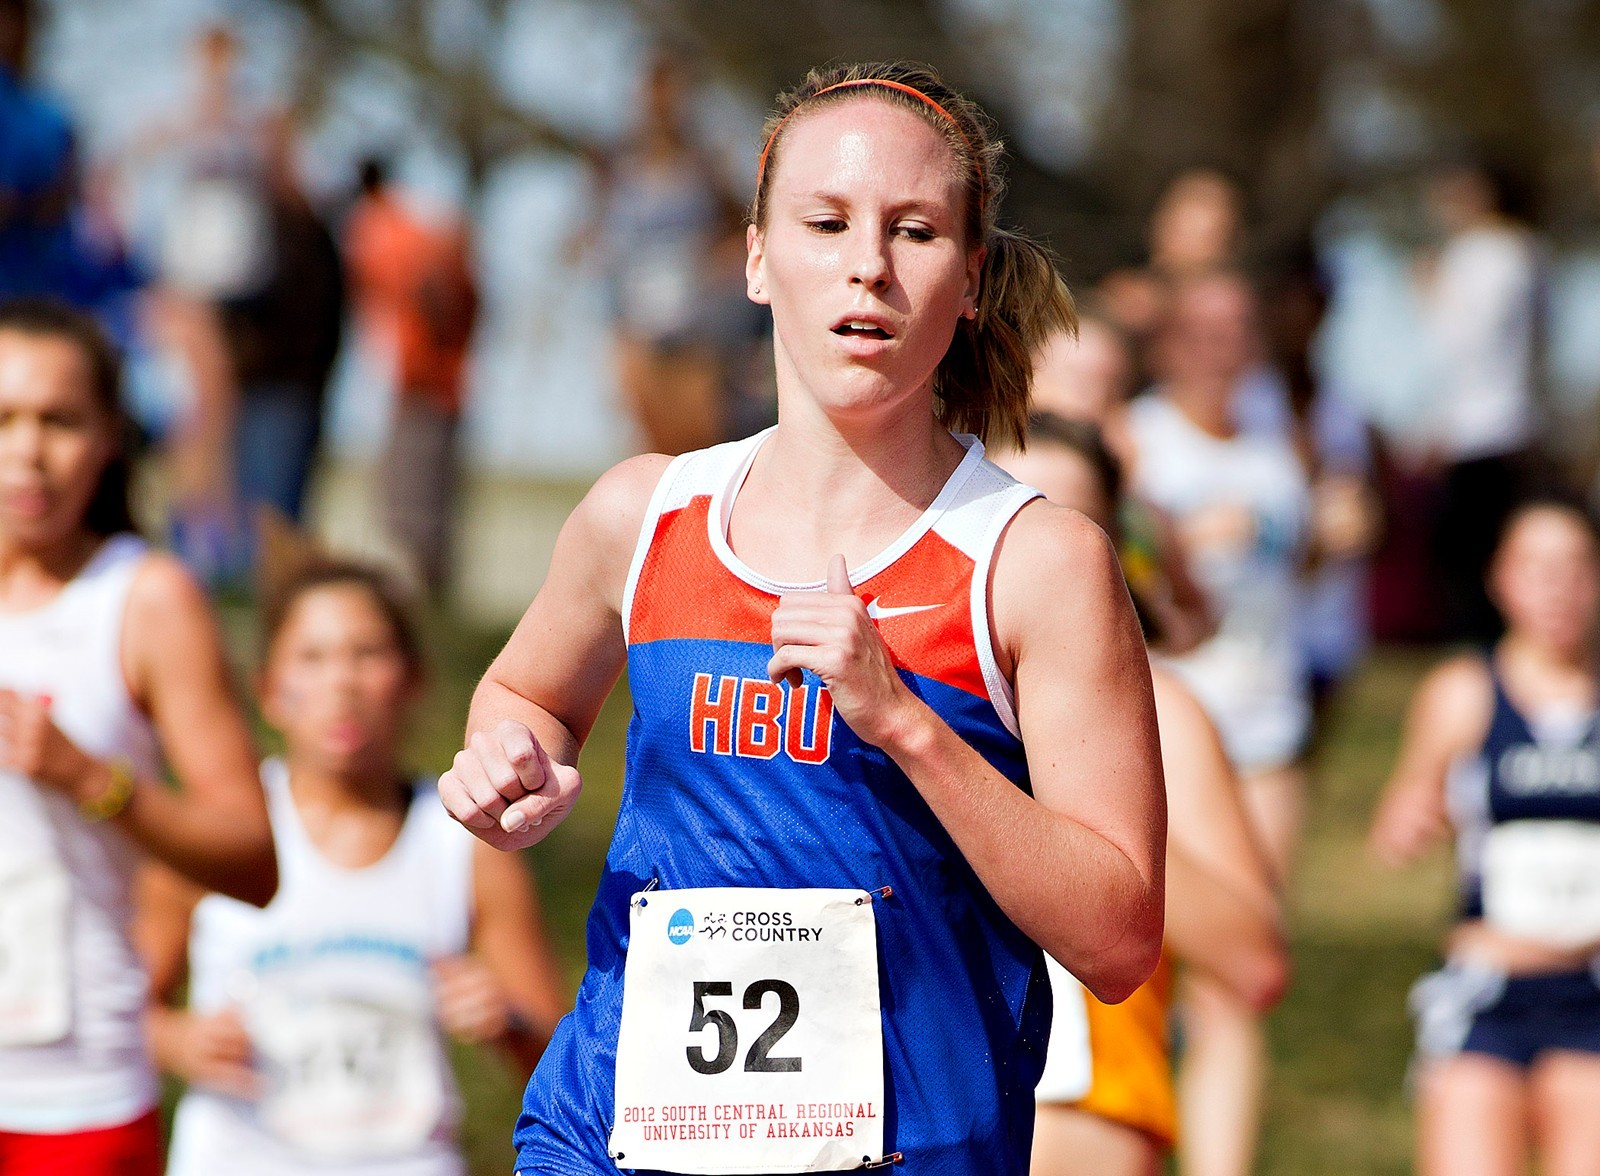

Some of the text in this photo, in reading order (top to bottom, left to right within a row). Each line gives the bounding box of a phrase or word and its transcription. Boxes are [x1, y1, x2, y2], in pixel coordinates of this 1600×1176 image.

[690, 672, 834, 765] HBU
[733, 912, 793, 926] CROSS
[668, 925, 694, 937] NCAA
[732, 928, 823, 942] COUNTRY
[686, 979, 802, 1075] 52
[624, 1103, 876, 1123] 2012 SOUTH CENTRAL REGIONAL
[643, 1122, 854, 1141] UNIVERSITY OF ARKANSAS
